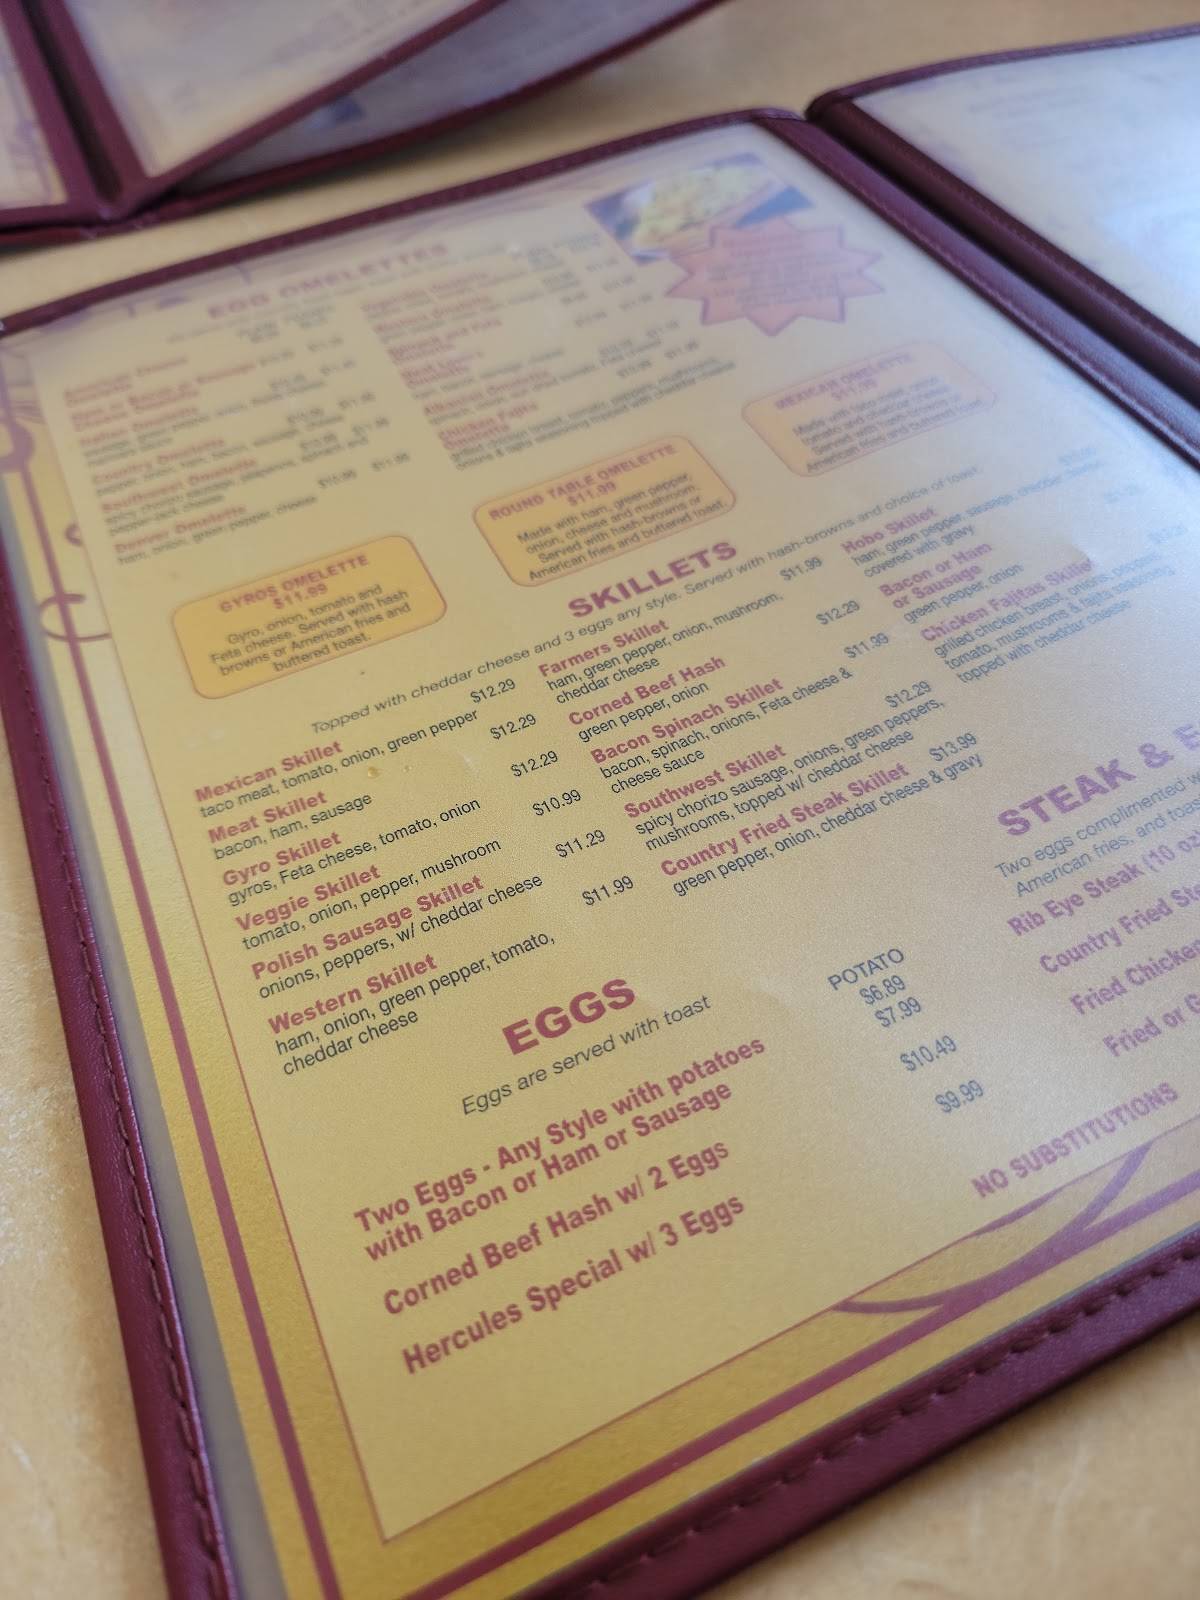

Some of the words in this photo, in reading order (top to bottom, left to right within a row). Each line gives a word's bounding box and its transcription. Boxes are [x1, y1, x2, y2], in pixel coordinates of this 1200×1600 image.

[487, 493, 545, 521] ROUND
[546, 474, 596, 499] TABLE
[596, 444, 677, 480] OMELETTE
[840, 531, 885, 554] Hobo
[884, 507, 938, 535] Skillet
[218, 585, 278, 613] GYROS
[280, 554, 370, 592] OMELETTE
[272, 582, 329, 610] $11.99
[307, 595, 356, 616] tomato
[357, 583, 383, 601] and
[567, 541, 737, 618] SKILLETS
[779, 555, 824, 581] $11.99
[877, 569, 934, 598] Bacon
[935, 559, 952, 573] or
[951, 543, 994, 565] Ham
[891, 594, 911, 609] or
[910, 565, 983, 600] Sausage
[209, 648, 242, 664] Feta
[297, 610, 345, 634] Served
[346, 601, 375, 618] with
[375, 589, 409, 607] hash
[218, 652, 271, 677] browns
[272, 646, 287, 658] or
[290, 624, 353, 651] American
[353, 613, 385, 629] fries
[385, 601, 412, 619] and
[815, 599, 861, 626] $12.29
[843, 632, 890, 659] $11.99
[271, 644, 331, 672] buttered
[331, 631, 372, 651] toast.
[537, 643, 612, 678] Farmers
[612, 619, 670, 649] Skillet
[469, 678, 516, 704] $12.29
[568, 691, 635, 726] Corned
[633, 673, 678, 700] Beef
[678, 656, 726, 682] Hash
[589, 734, 651, 764] Bacon
[650, 703, 725, 739] Spinach
[724, 678, 784, 710] Skillet
[884, 680, 933, 709] $12.29
[489, 713, 537, 740] $12.29
[928, 732, 978, 762] $13.99
[193, 766, 278, 803] Mexican
[280, 740, 343, 772] Skillet
[199, 799, 235, 818] taco
[237, 783, 280, 806] meat,
[280, 763, 339, 790] tomato,
[340, 746, 386, 768] onion,
[386, 728, 428, 754] green
[428, 709, 478, 738] pepper
[509, 749, 559, 778] $12.29
[623, 769, 726, 819] Southwest
[724, 744, 787, 778] Skillet
[997, 759, 1137, 836] STEAK
[1138, 743, 1175, 769] &
[207, 815, 260, 844] Meat
[262, 791, 328, 824] Skillet
[212, 835, 268, 861] bacon,
[268, 820, 309, 840] ham,
[309, 794, 373, 825] sausage
[531, 788, 582, 817] $10.99
[660, 837, 740, 876] Country
[738, 813, 792, 845] Fried
[790, 791, 849, 823] Steak
[847, 763, 910, 798] Skillet
[994, 856, 1032, 879] Two
[1034, 836, 1074, 860] eggs
[1076, 777, 1187, 841] complimented
[221, 860, 272, 886] Gyro
[275, 831, 342, 867] Skillet
[227, 879, 278, 908] gyros,
[278, 863, 316, 885] Feta
[317, 841, 378, 870] cheese,
[377, 818, 438, 846] tomato,
[438, 799, 482, 823] onion
[554, 829, 606, 859] $11.29
[234, 896, 310, 931] Veggie
[313, 864, 382, 902] Skillet
[241, 920, 306, 951] tomato,
[308, 899, 358, 925] onion,
[359, 873, 420, 908] pepper,
[419, 840, 502, 880] mushroom
[581, 875, 635, 907] $11.99
[1007, 911, 1046, 937] Rib
[1042, 893, 1085, 919] Eye
[1082, 862, 1145, 899] Steak
[251, 943, 319, 981] Polish
[322, 906, 413, 952] Sausage
[415, 875, 485, 913] Skillet
[258, 968, 321, 999] onions,
[321, 937, 395, 978] peppers,
[395, 921, 416, 943] w/
[419, 898, 484, 933] cheddar
[486, 875, 544, 906] cheese
[1039, 926, 1122, 973] Country
[1118, 897, 1173, 935] Fried
[267, 987, 363, 1035] Western
[365, 953, 438, 995] Skillet
[274, 1030, 321, 1056] ham,
[322, 1007, 377, 1036] onion,
[378, 984, 427, 1017] green
[427, 958, 492, 996] pepper,
[490, 932, 556, 965] tomato,
[826, 947, 906, 991] POTATO
[858, 974, 907, 1006] $6.89
[282, 1036, 354, 1076] cheddar
[357, 1010, 419, 1045] cheese
[501, 978, 636, 1056] EGGS
[874, 996, 923, 1029] $7.99
[461, 1083, 513, 1116] Eggs
[517, 1068, 548, 1091] are
[551, 1033, 617, 1075] served
[619, 1017, 661, 1045] with
[662, 995, 712, 1026] toast
[899, 1034, 958, 1073] $10.49
[934, 1079, 985, 1114] $9.99
[353, 1197, 411, 1232] Two
[413, 1167, 478, 1207] Eggs
[497, 1136, 542, 1170] Any
[545, 1108, 608, 1146] Style
[610, 1081, 665, 1116] with
[666, 1039, 766, 1097] potatoes
[971, 1168, 1009, 1198] NO
[1008, 1082, 1179, 1179] SUBSTITUTIONS
[364, 1221, 423, 1262] with
[425, 1185, 508, 1234] Bacon
[512, 1169, 537, 1194] or
[540, 1143, 601, 1181] Ham
[603, 1128, 628, 1151] or
[631, 1083, 732, 1138] Sausage
[383, 1253, 479, 1315] Corned
[480, 1221, 543, 1270] Beef
[545, 1193, 614, 1239] Hash
[615, 1174, 644, 1205] w/
[647, 1165, 669, 1191] 2
[667, 1142, 730, 1180] Eggs
[401, 1303, 524, 1375] Hercules
[525, 1248, 624, 1313] Special
[625, 1231, 656, 1264] w/
[658, 1222, 680, 1247] 3
[679, 1196, 745, 1237] Eggs
